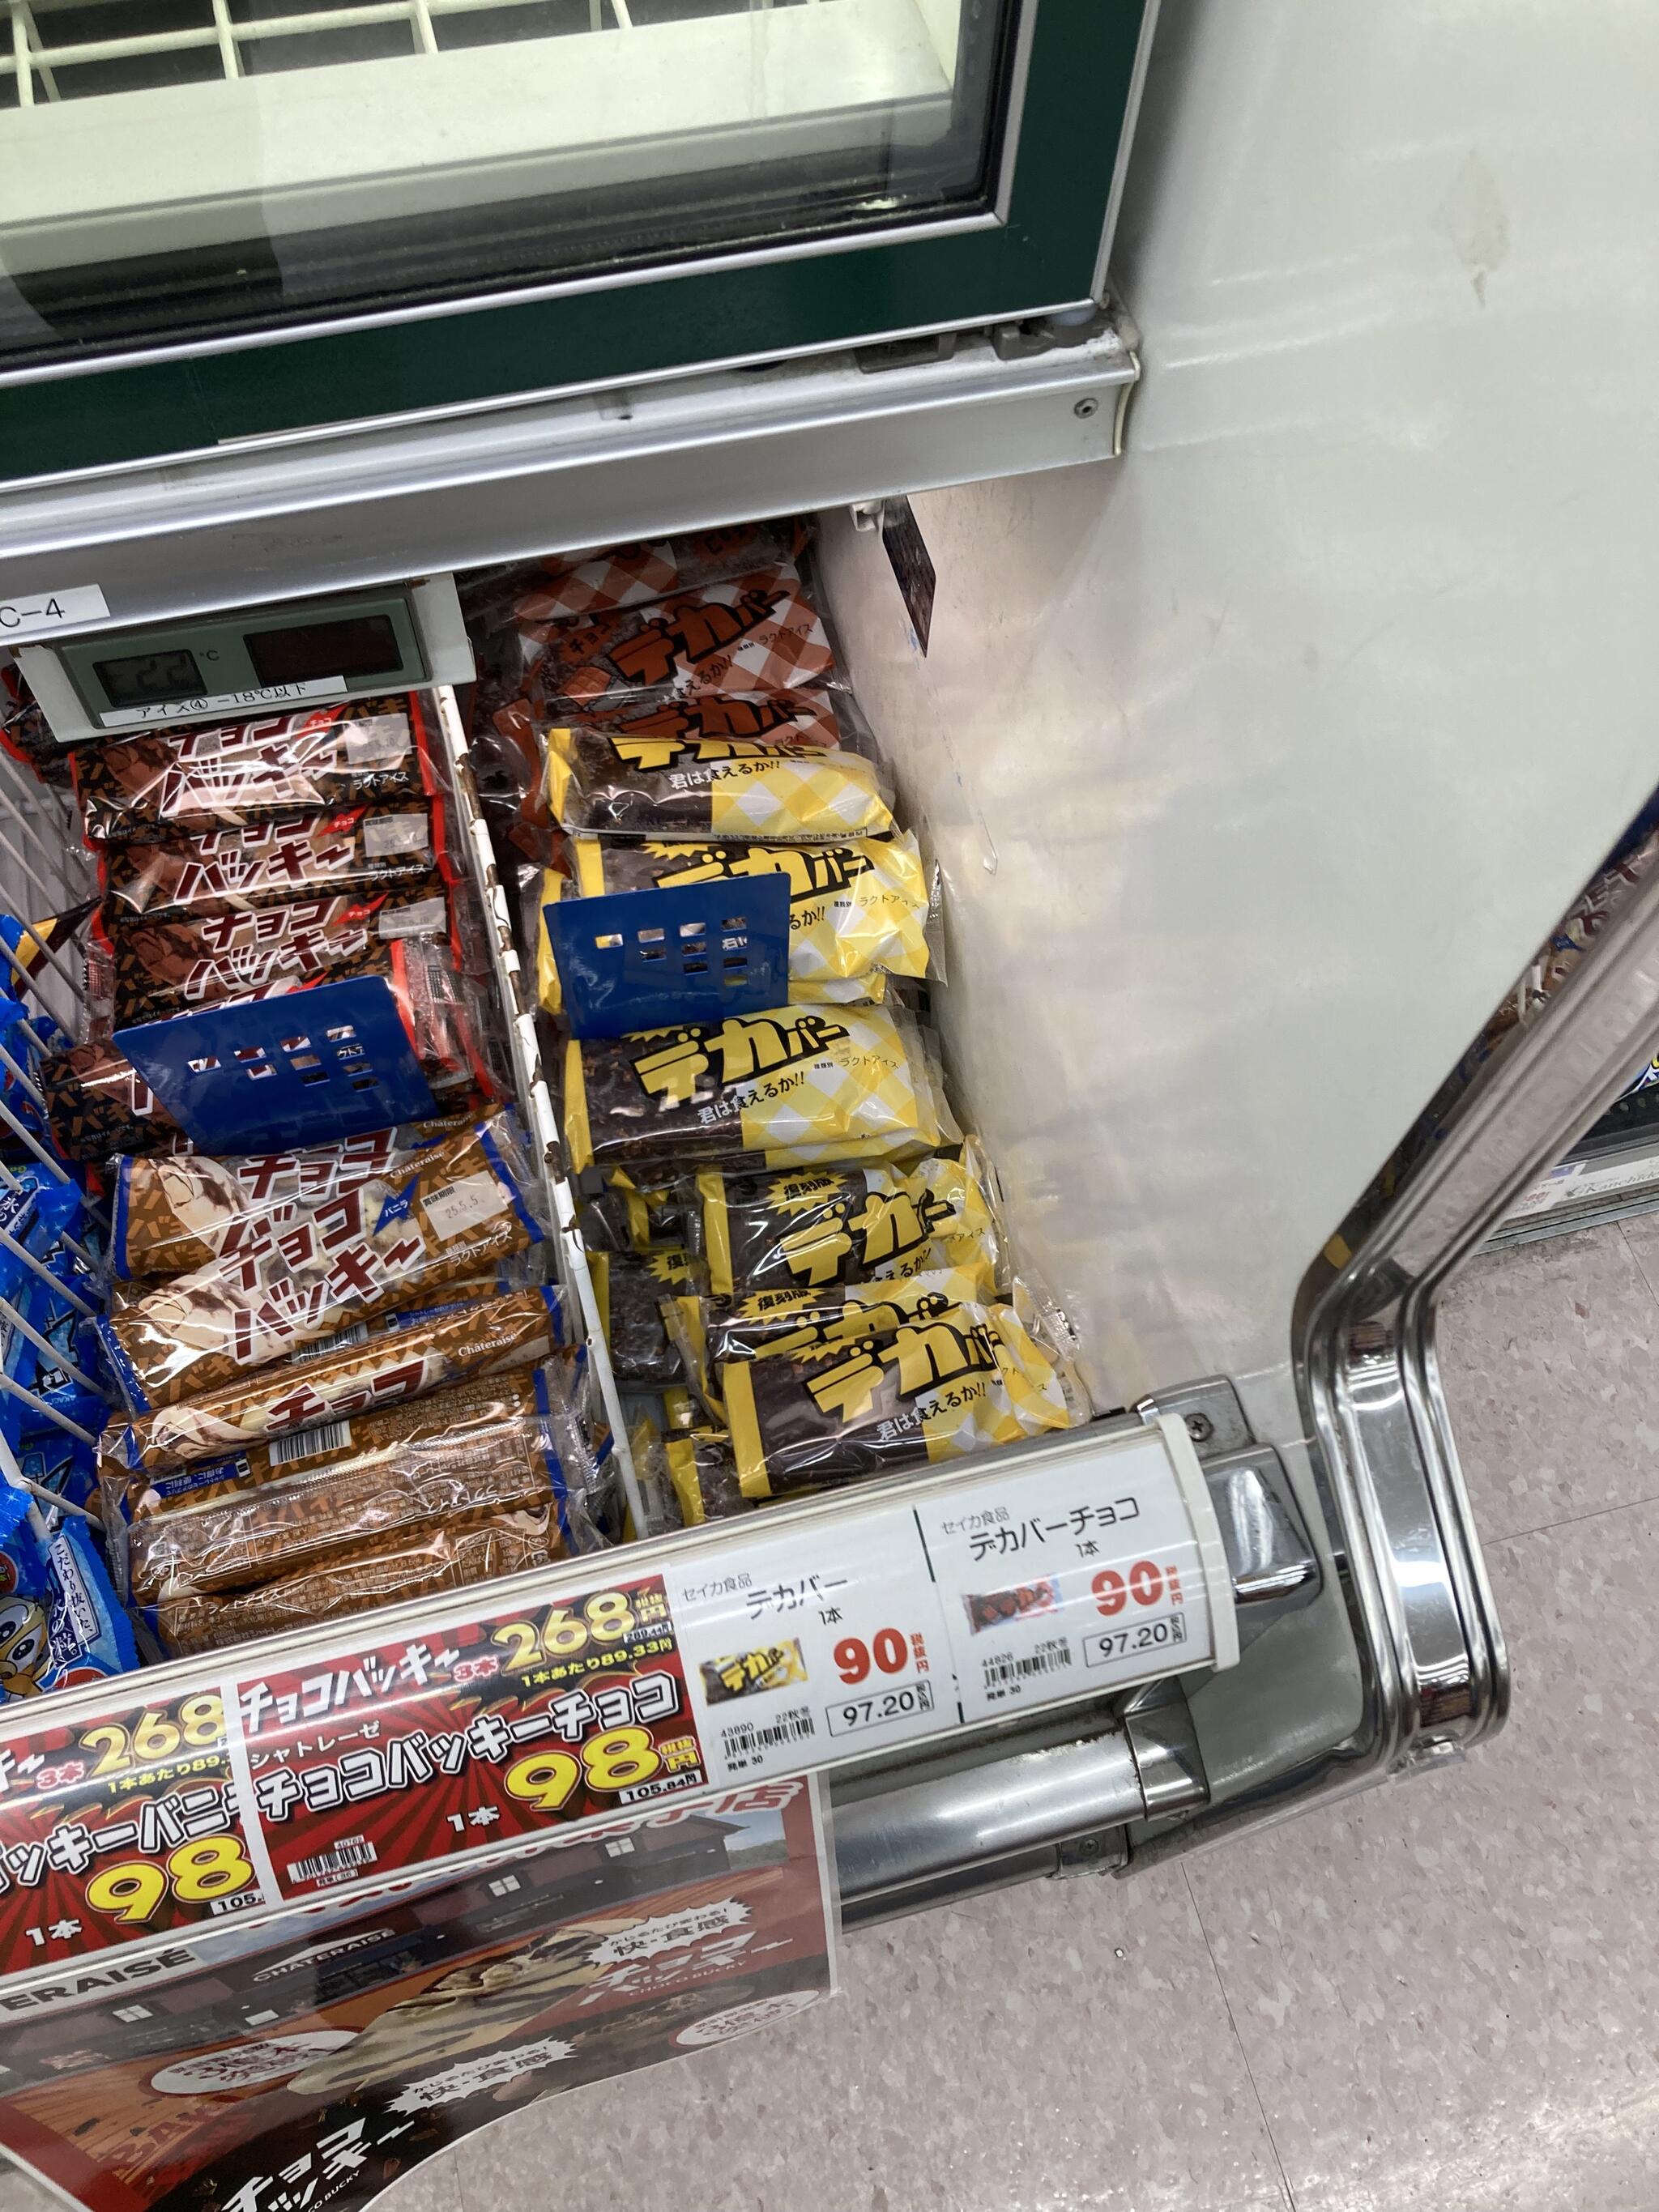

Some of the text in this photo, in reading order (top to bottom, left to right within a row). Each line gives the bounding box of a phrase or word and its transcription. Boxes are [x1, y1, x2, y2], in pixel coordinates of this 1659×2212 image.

[608, 589, 791, 685] デカバー
[173, 838, 355, 906] バッキー
[201, 896, 342, 953] チョコ
[184, 928, 368, 1000] バッキー
[631, 1015, 851, 1104] デカバー
[840, 1055, 900, 1070] ラクトアイス
[697, 1071, 806, 1125] 君は食えるか!!
[384, 1199, 410, 1217] バニラ
[234, 1235, 426, 1366] バッキー
[876, 1381, 986, 1441] 君は食えるか!!
[941, 1506, 1011, 1535] セイカ食品
[969, 1496, 1141, 1562] デカバーチョコ
[682, 1572, 753, 1602] セイカ食品
[746, 1574, 849, 1621] デカバー
[1090, 1559, 1164, 1617] 90
[818, 1607, 843, 1626] 1本
[1098, 1622, 1168, 1657] 97.20
[240, 1592, 640, 1734] チョコバッキー 3本 268
[521, 1637, 674, 1688] 1本あたり89.33円
[833, 1627, 909, 1686] 90
[79, 1693, 227, 1779] 268
[842, 1690, 915, 1727] 97.20
[250, 1719, 381, 1770] シャトレーゼ
[254, 1669, 679, 1822] チョコバッキーチョコ
[751, 1755, 764, 1765] 30
[447, 1805, 501, 1833] 1本
[505, 1726, 663, 1811] 98
[625, 1773, 697, 1801] 105.84円
[25, 1918, 83, 1947] 1本
[85, 1833, 256, 1924] 98
